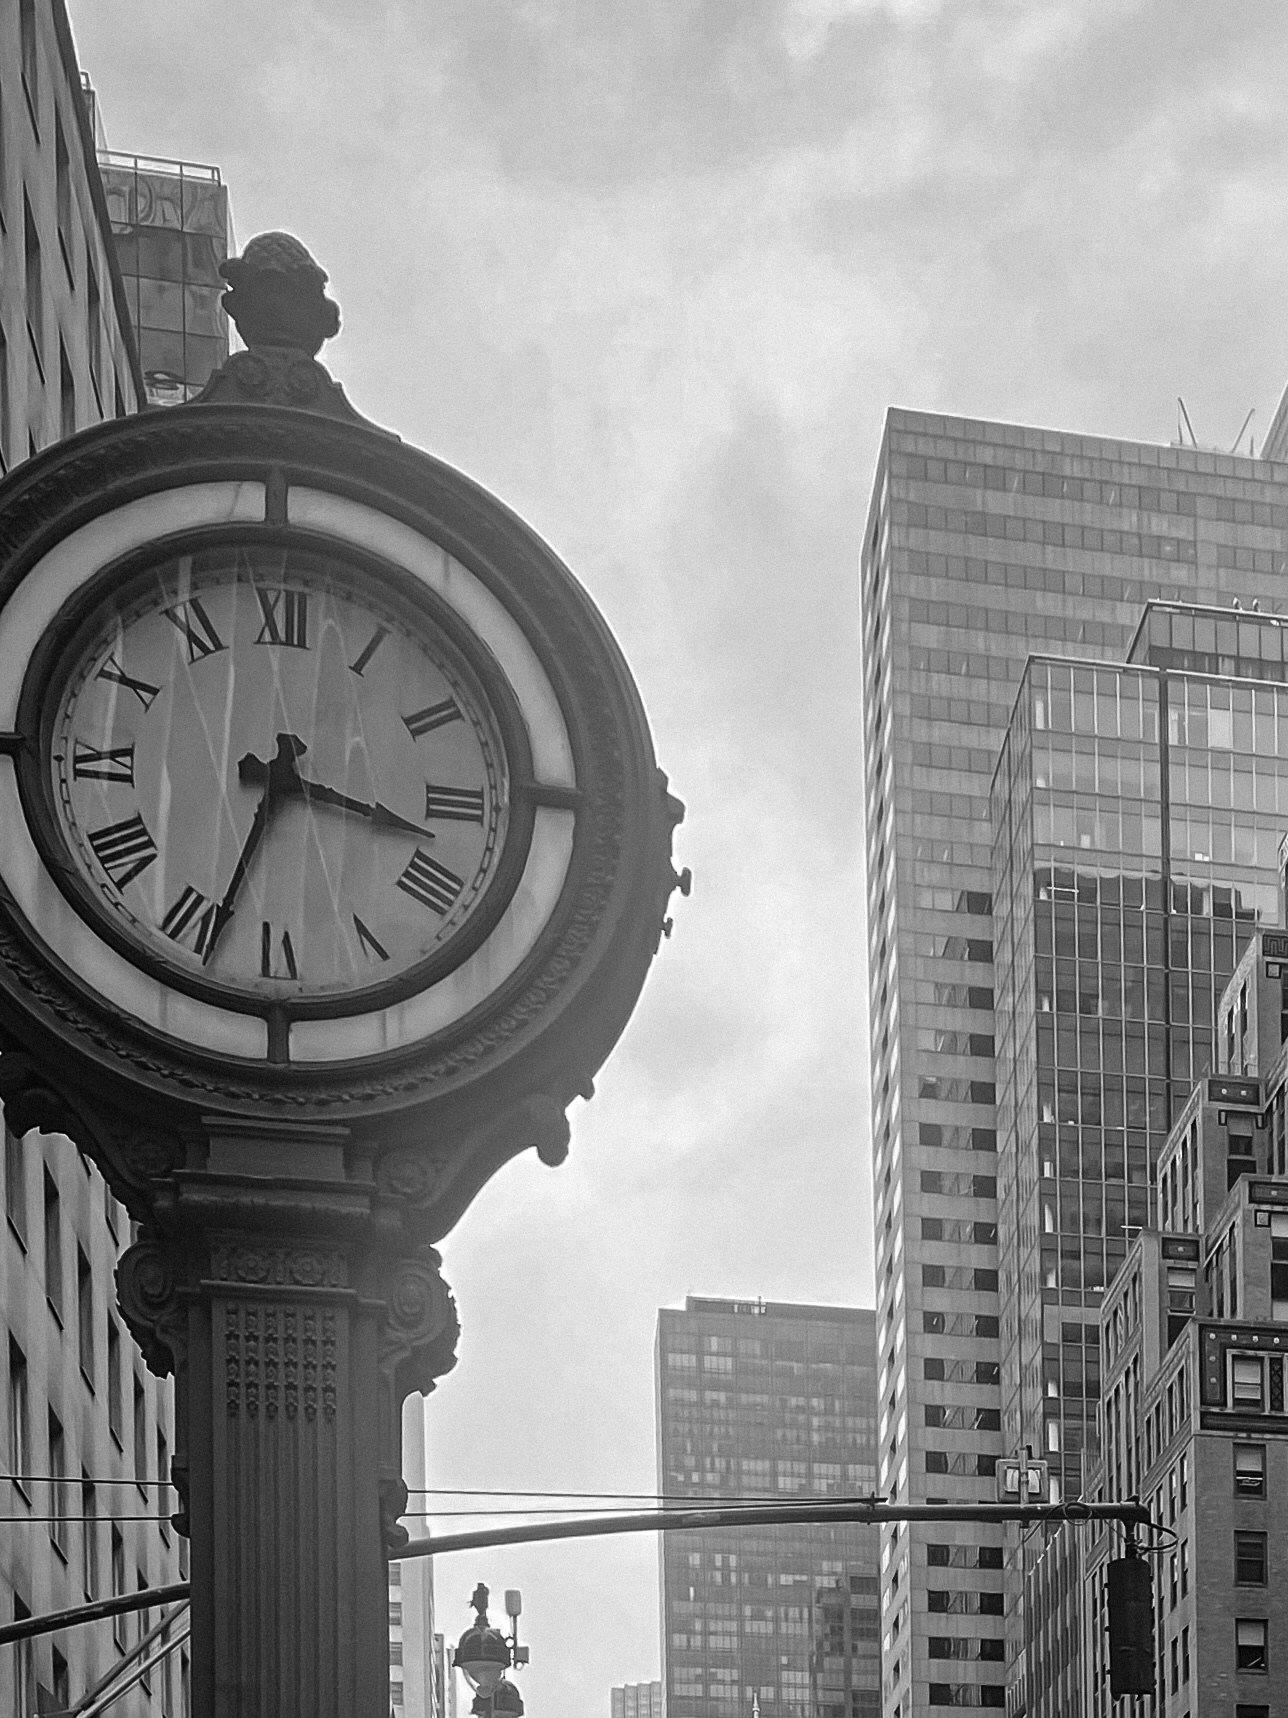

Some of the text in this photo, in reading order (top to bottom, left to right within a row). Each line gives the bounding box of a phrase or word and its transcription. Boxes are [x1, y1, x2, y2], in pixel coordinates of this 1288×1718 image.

[160, 596, 229, 664] XI
[255, 587, 311, 649] XII
[348, 625, 392, 678] I
[95, 652, 165, 713] X
[400, 695, 465, 741] II
[73, 738, 135, 788] IX
[425, 782, 484, 826] III
[87, 812, 158, 894] VIII
[261, 920, 299, 980] VI
